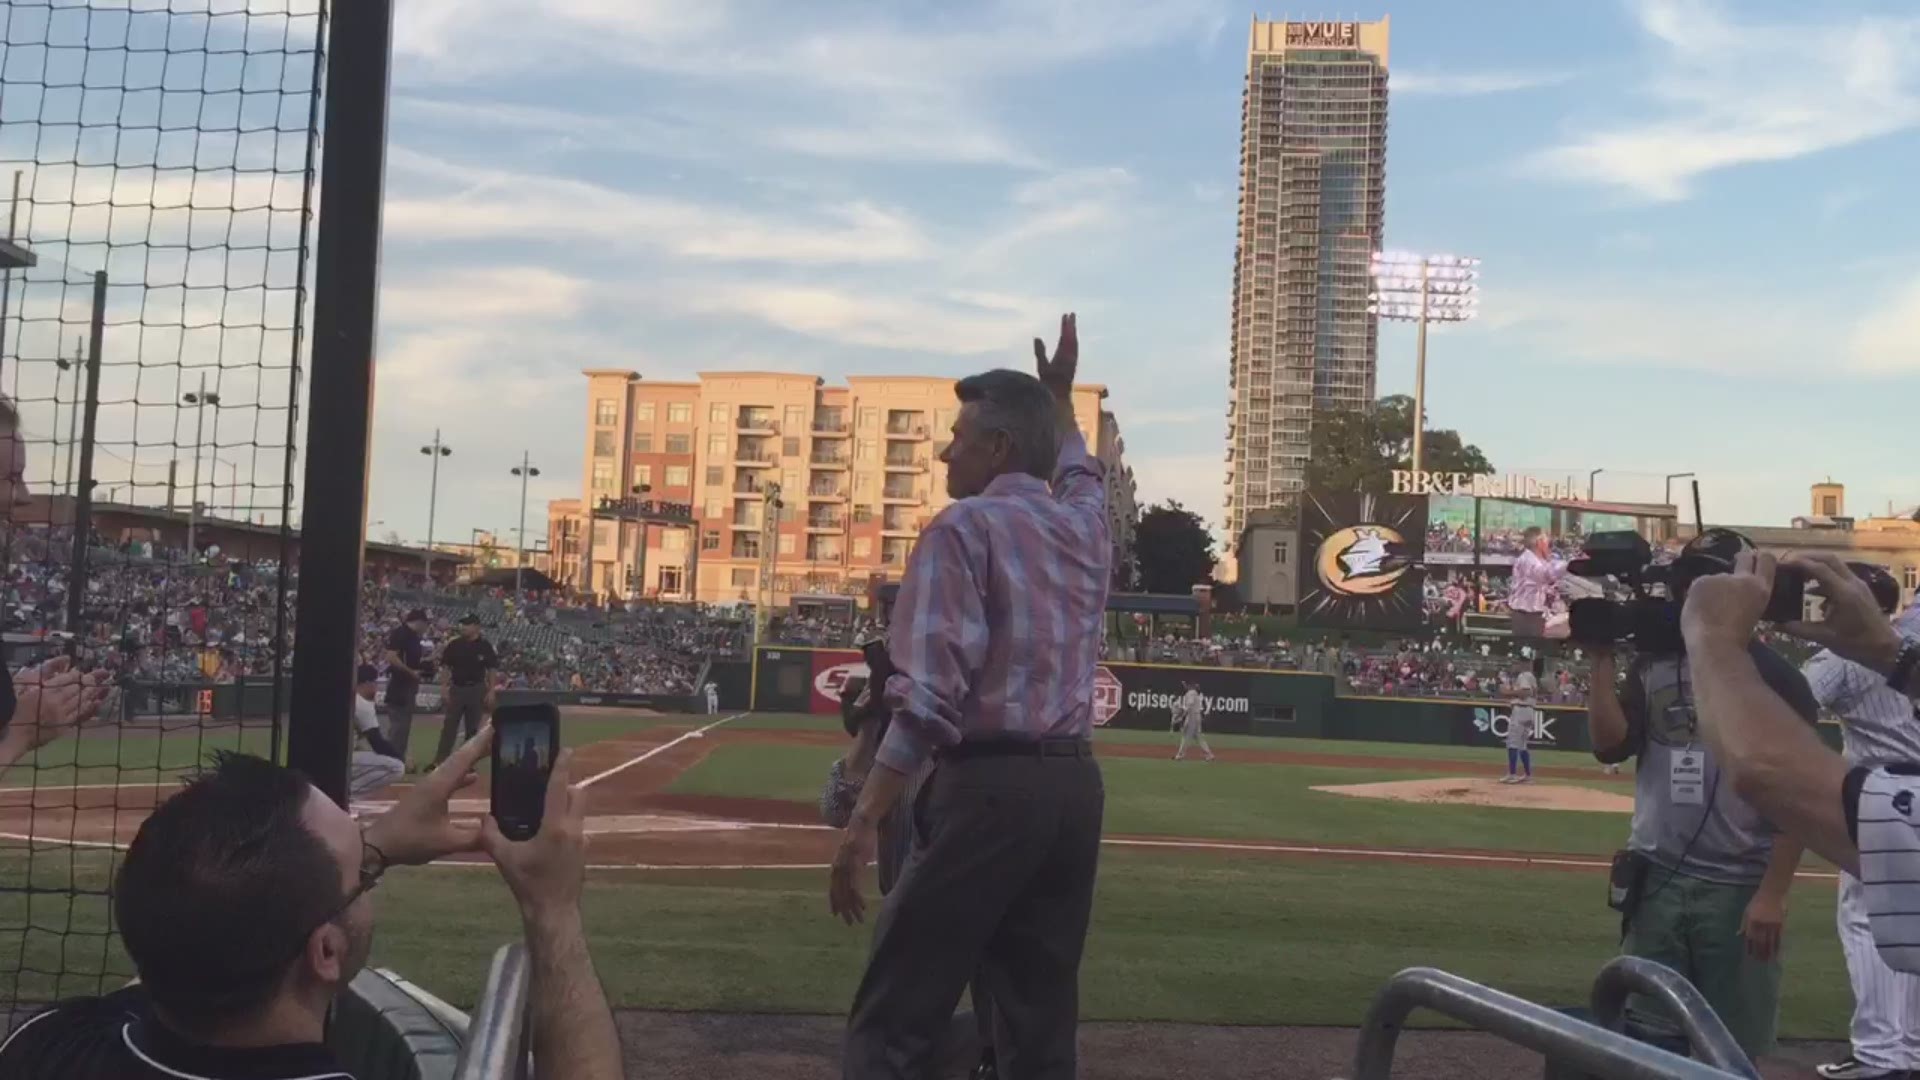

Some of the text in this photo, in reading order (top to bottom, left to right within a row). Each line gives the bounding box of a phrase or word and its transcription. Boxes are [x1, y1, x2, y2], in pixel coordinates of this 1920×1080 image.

[1305, 22, 1353, 38] VUE
[1391, 469, 1467, 496] BB&T
[1490, 708, 1557, 740] blk
